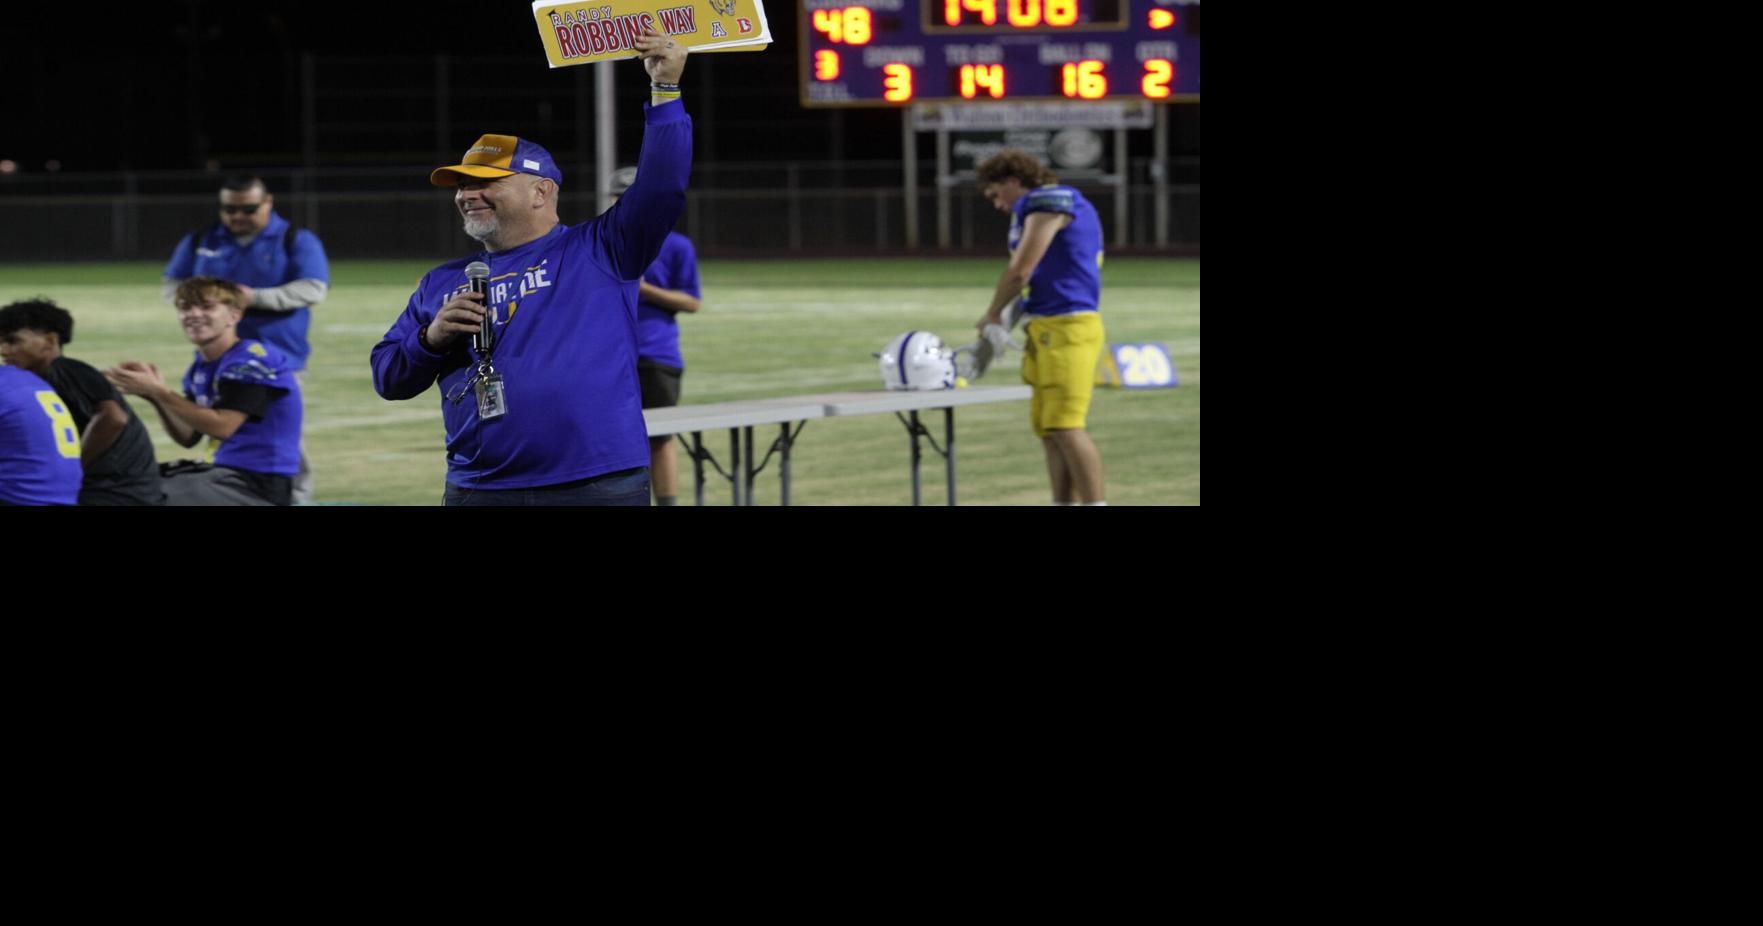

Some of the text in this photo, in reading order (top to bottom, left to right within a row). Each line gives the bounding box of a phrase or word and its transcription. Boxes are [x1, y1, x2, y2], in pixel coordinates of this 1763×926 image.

[551, 6, 611, 26] RANDY
[657, 5, 697, 36] WAY
[812, 6, 872, 44] 48
[814, 49, 840, 81] 3
[883, 63, 913, 102] 3
[960, 64, 1005, 99] 14
[1062, 60, 1107, 99] 16
[1142, 59, 1173, 98] 2
[1117, 344, 1173, 386] 20
[34, 391, 81, 458] 8
